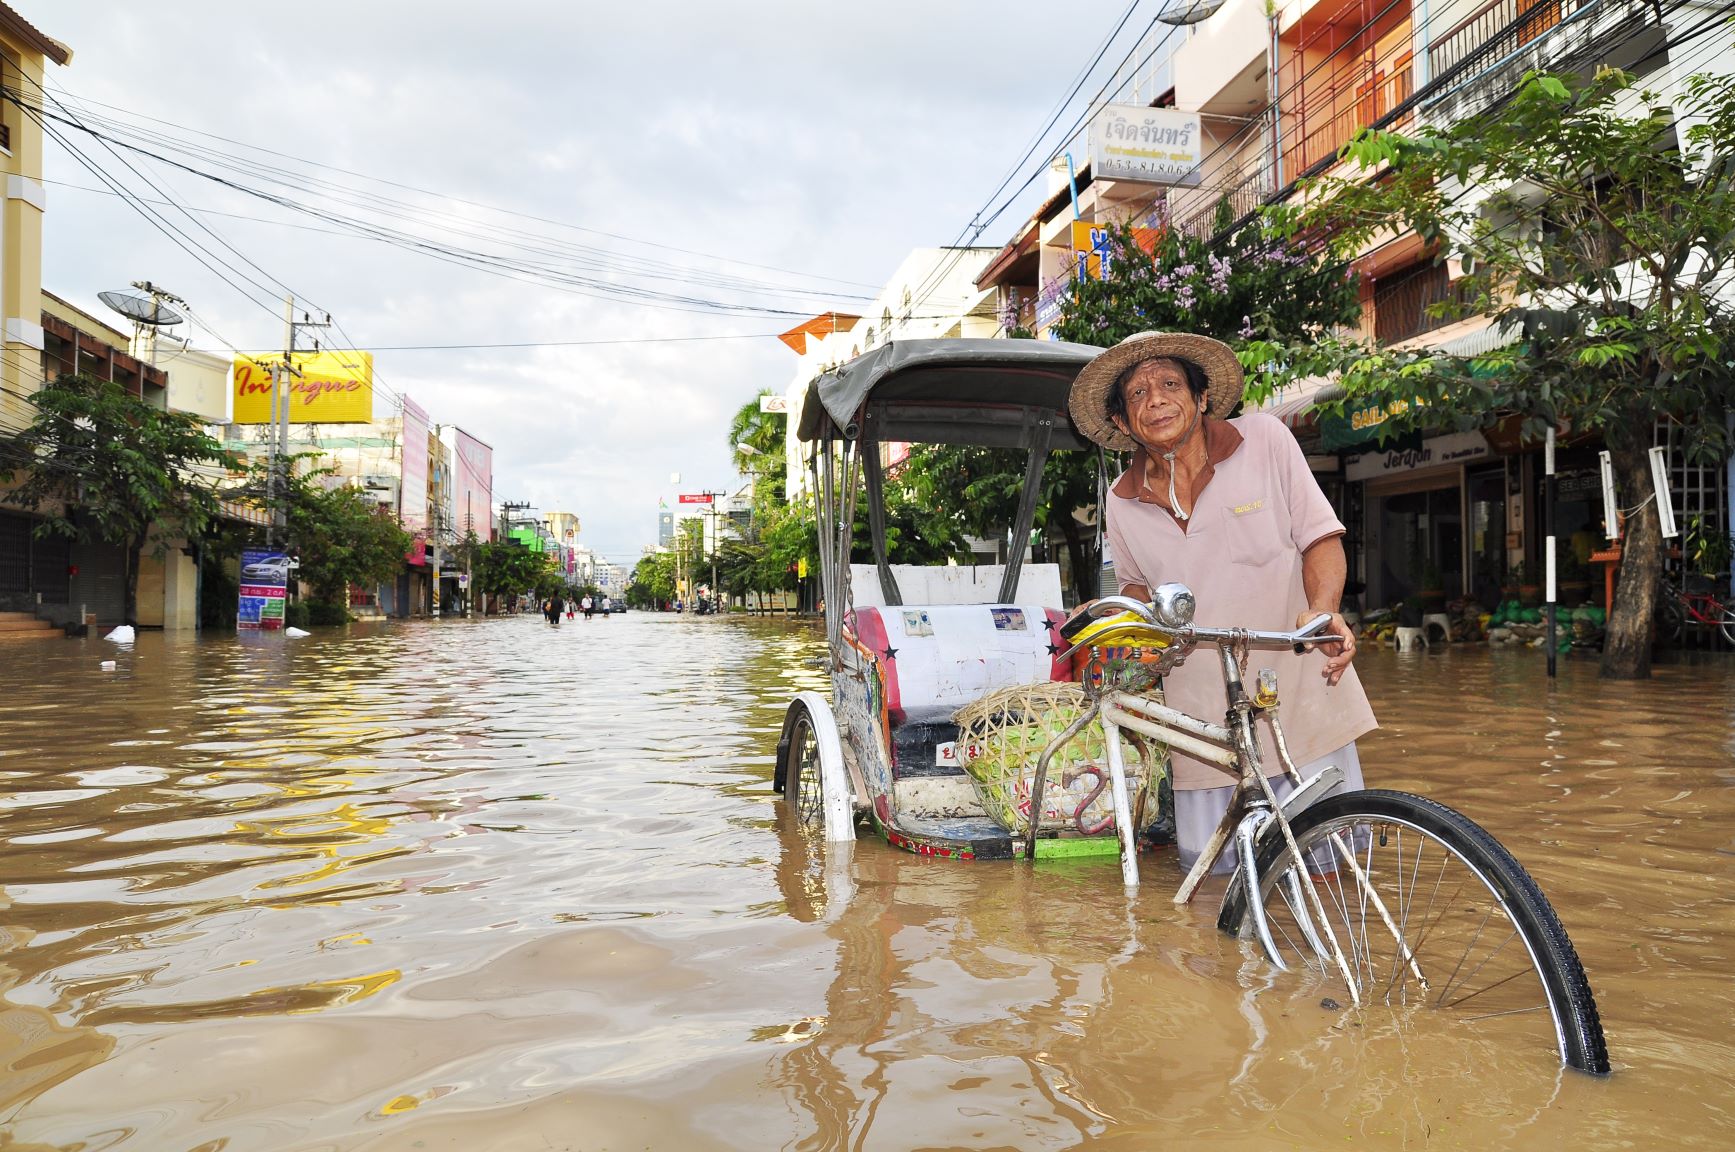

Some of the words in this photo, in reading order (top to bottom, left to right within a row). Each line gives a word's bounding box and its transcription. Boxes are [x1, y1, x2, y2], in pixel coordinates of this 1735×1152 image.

[1105, 117, 1193, 146] เจิดจันทร์
[235, 366, 361, 405] Intigue
